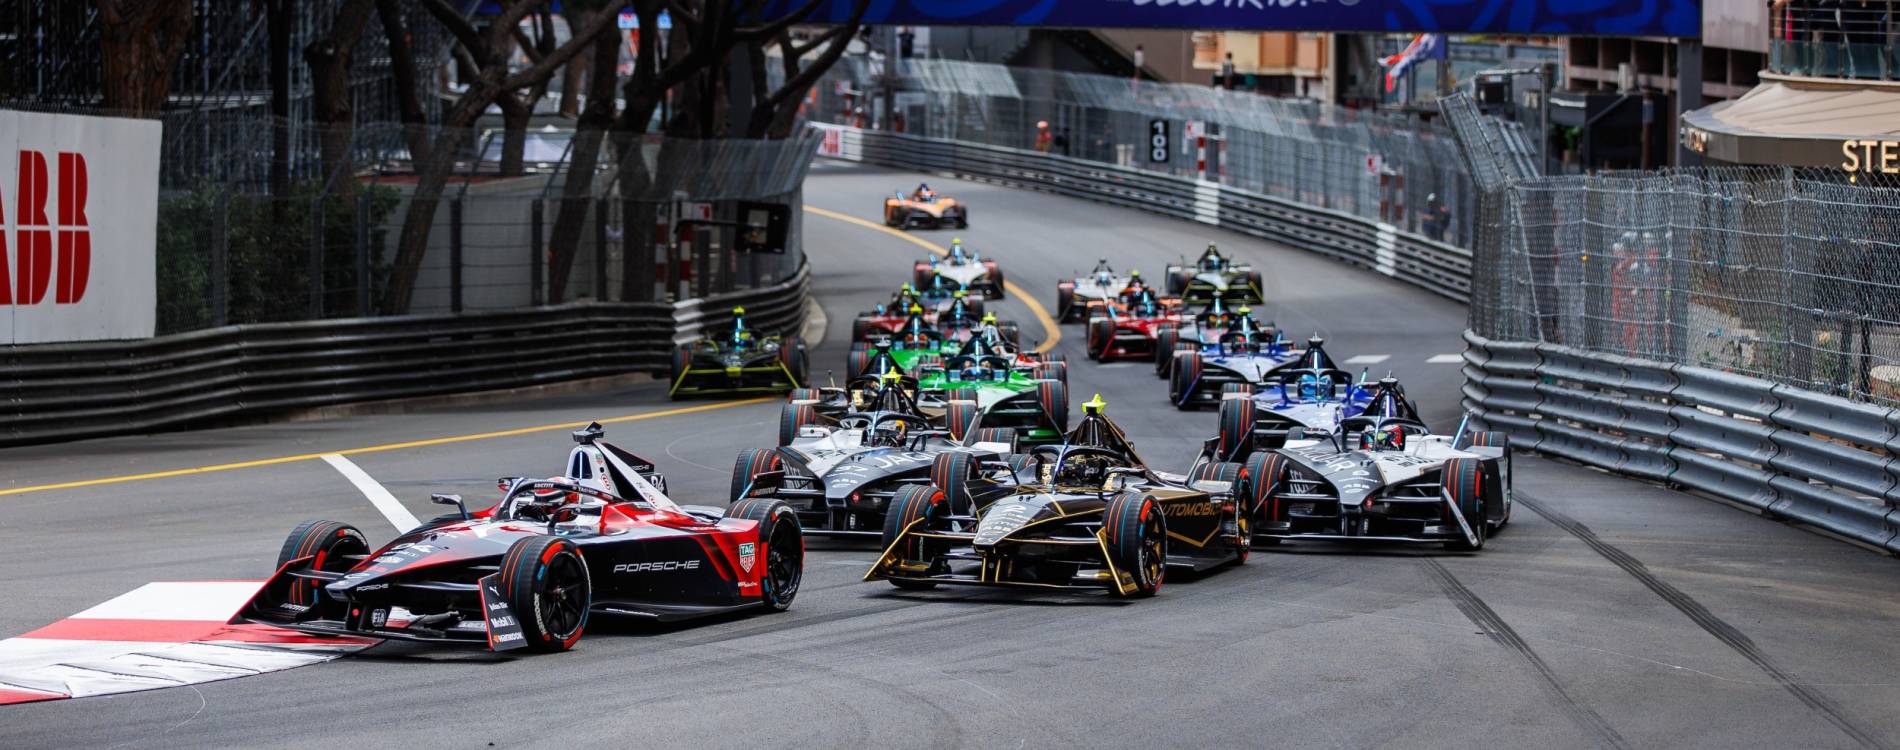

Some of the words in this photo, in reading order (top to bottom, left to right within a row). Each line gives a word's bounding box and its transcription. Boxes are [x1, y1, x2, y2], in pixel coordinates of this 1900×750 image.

[1153, 121, 1166, 161] 100
[1842, 140, 1899, 173] STE
[0, 149, 91, 305] BB
[741, 545, 754, 555] TAG
[613, 560, 700, 573] PORSCHE
[356, 583, 389, 592] PORSCHE
